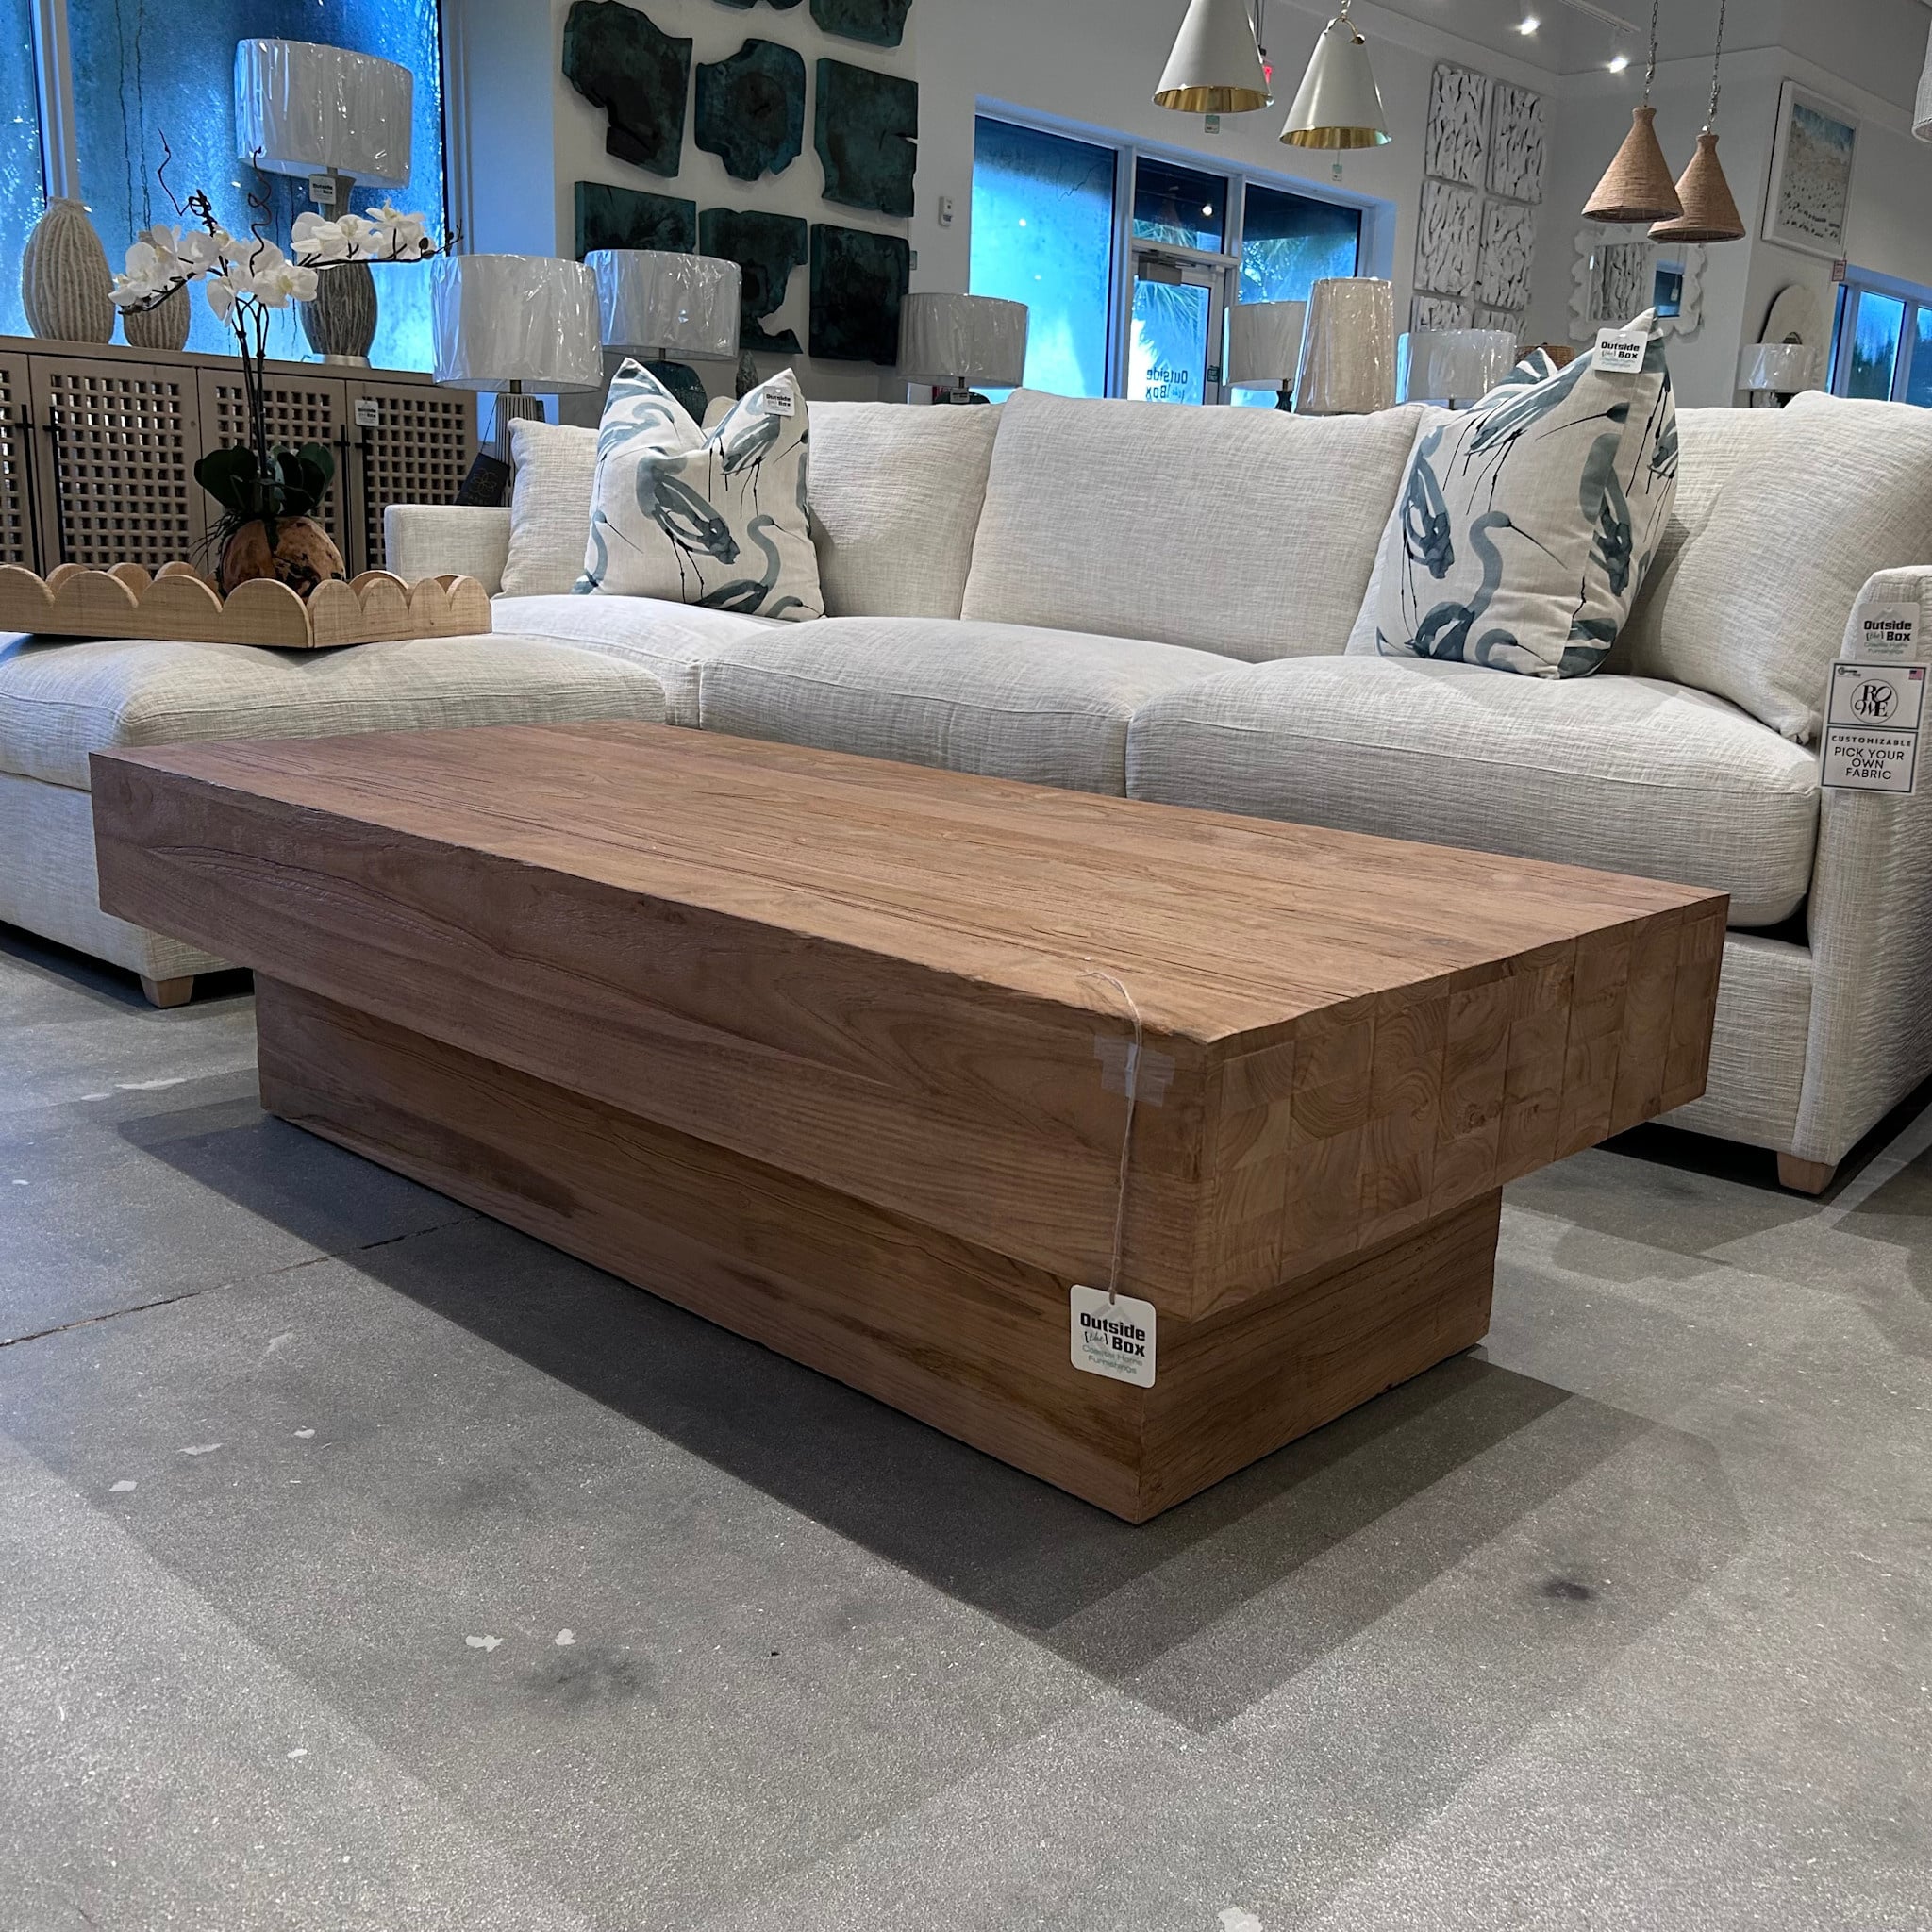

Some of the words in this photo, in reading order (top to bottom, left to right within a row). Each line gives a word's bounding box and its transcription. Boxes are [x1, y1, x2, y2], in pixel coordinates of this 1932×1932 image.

[1601, 341, 1640, 351] Outside
[1864, 620, 1912, 630] Outside
[1886, 631, 1911, 641] Box
[1831, 735, 1912, 747] CUSTOMIZABLE
[1834, 746, 1864, 758] PICK
[1868, 749, 1905, 760] YOUR
[1852, 758, 1884, 769] OWN
[1845, 767, 1891, 780] FABRIC
[1080, 1312, 1146, 1341] Outside
[1112, 1336, 1145, 1357] Box
